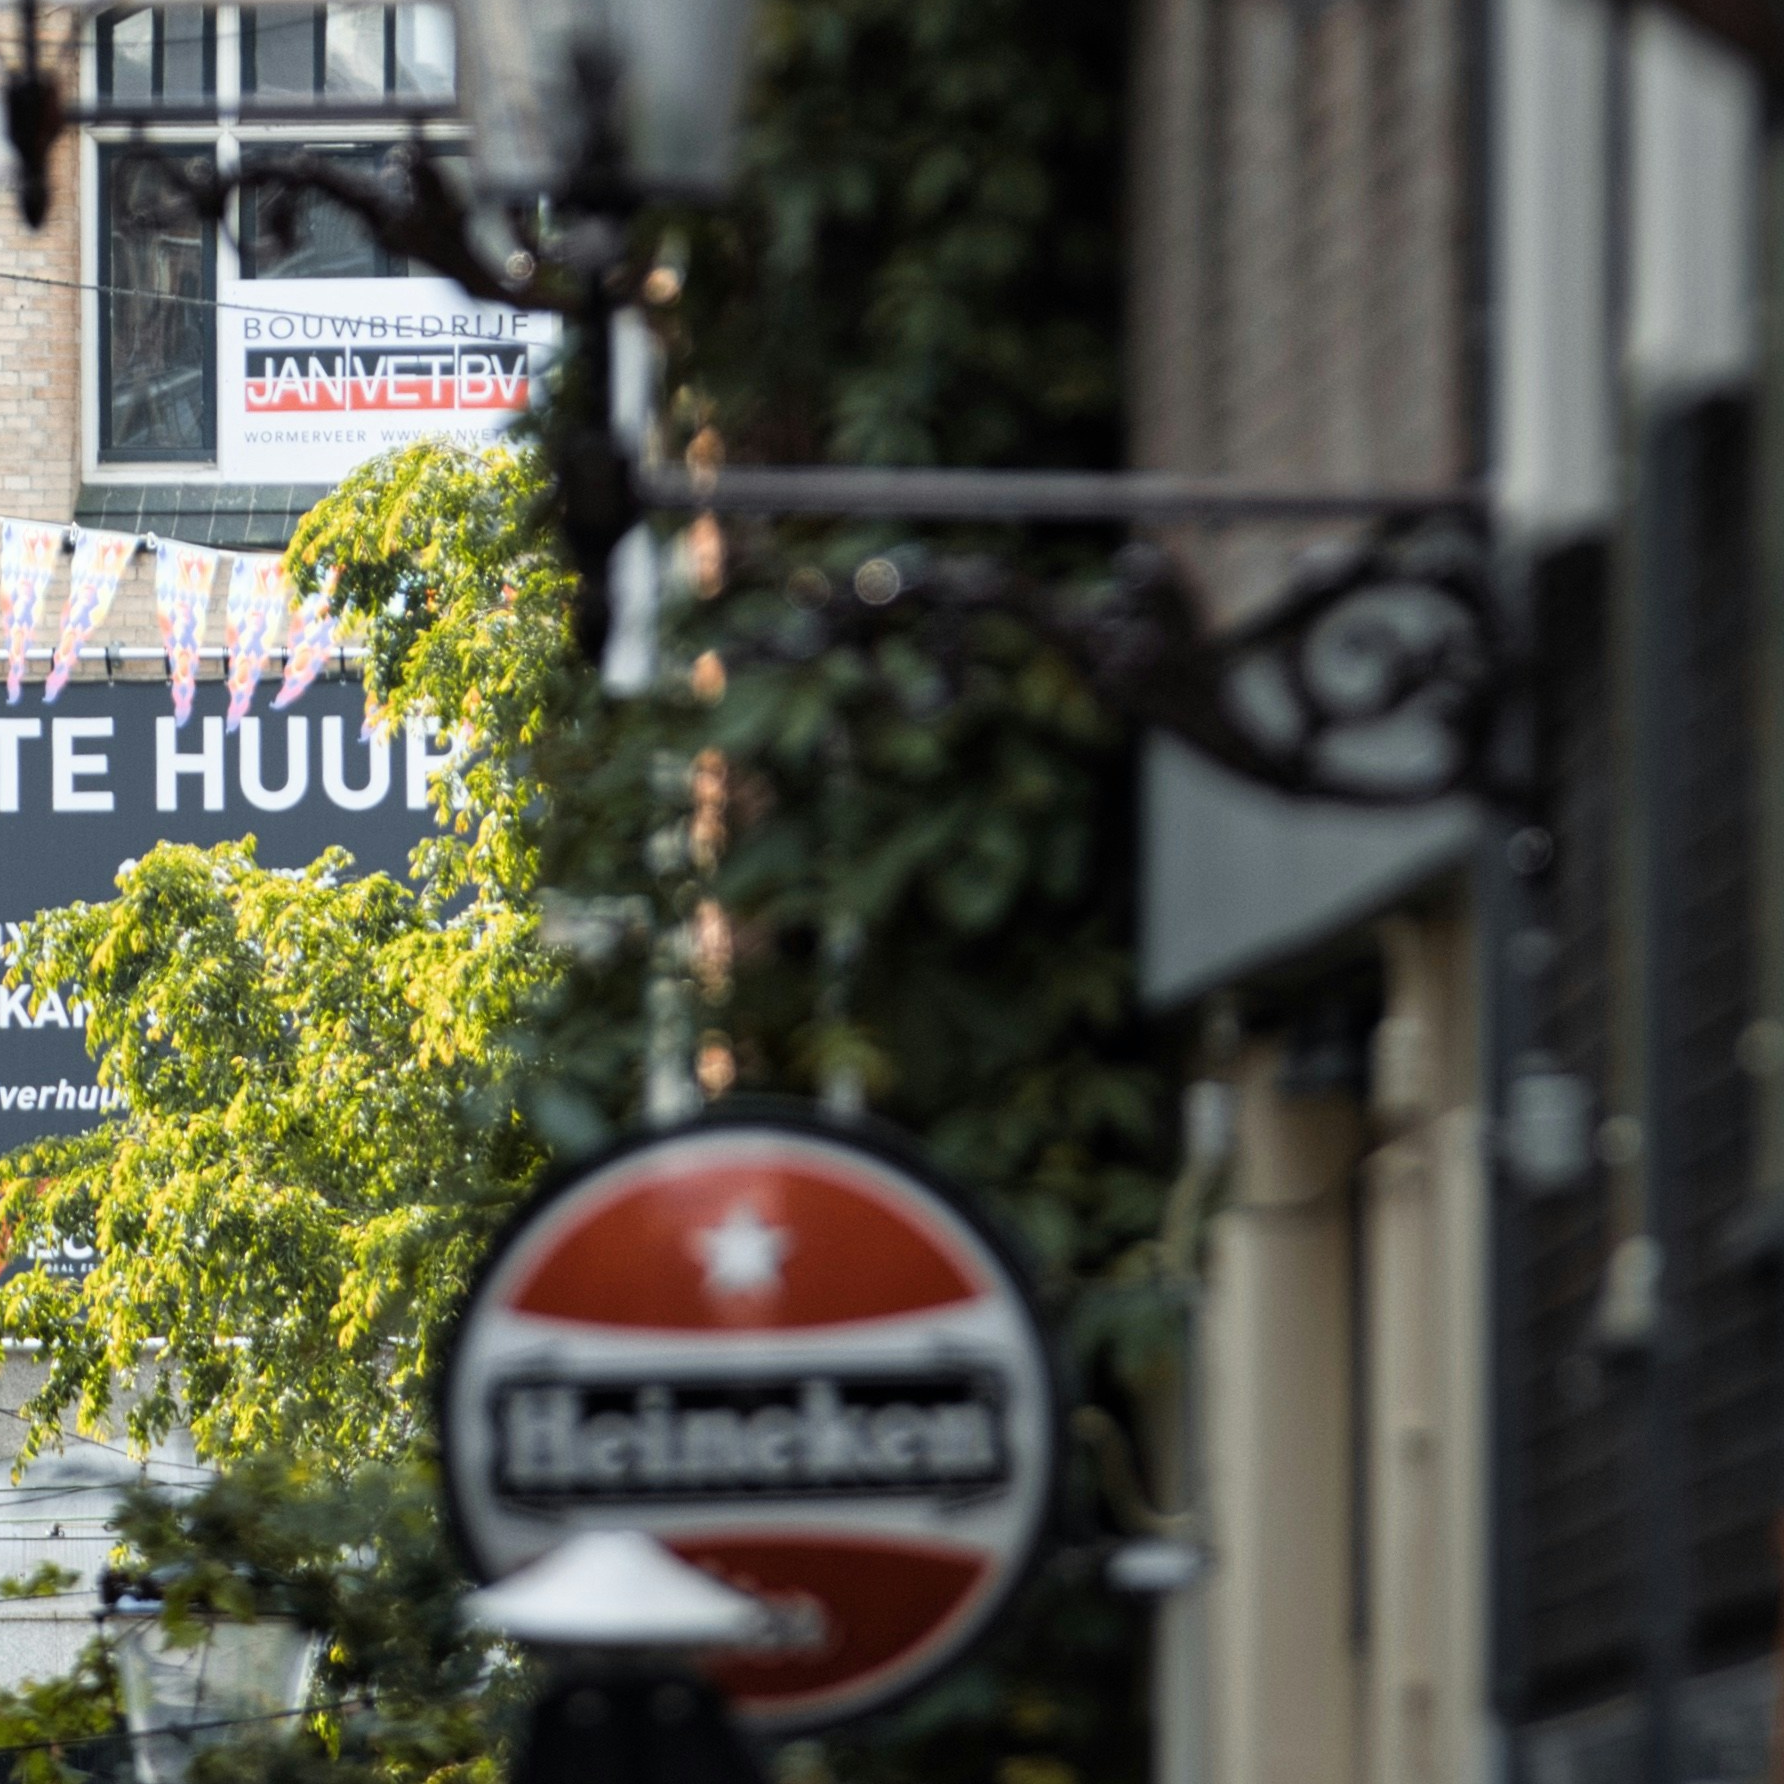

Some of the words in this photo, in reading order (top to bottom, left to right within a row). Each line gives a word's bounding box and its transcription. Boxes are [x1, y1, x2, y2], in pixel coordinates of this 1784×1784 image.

[243, 314, 530, 339] BOUWBEDRIJF
[247, 357, 344, 404] JAN
[352, 355, 454, 403] VET
[460, 354, 526, 402] BV
[244, 429, 367, 443] WORMERVEER
[155, 715, 471, 812] HUUR
[504, 1378, 996, 1481] Heineken
